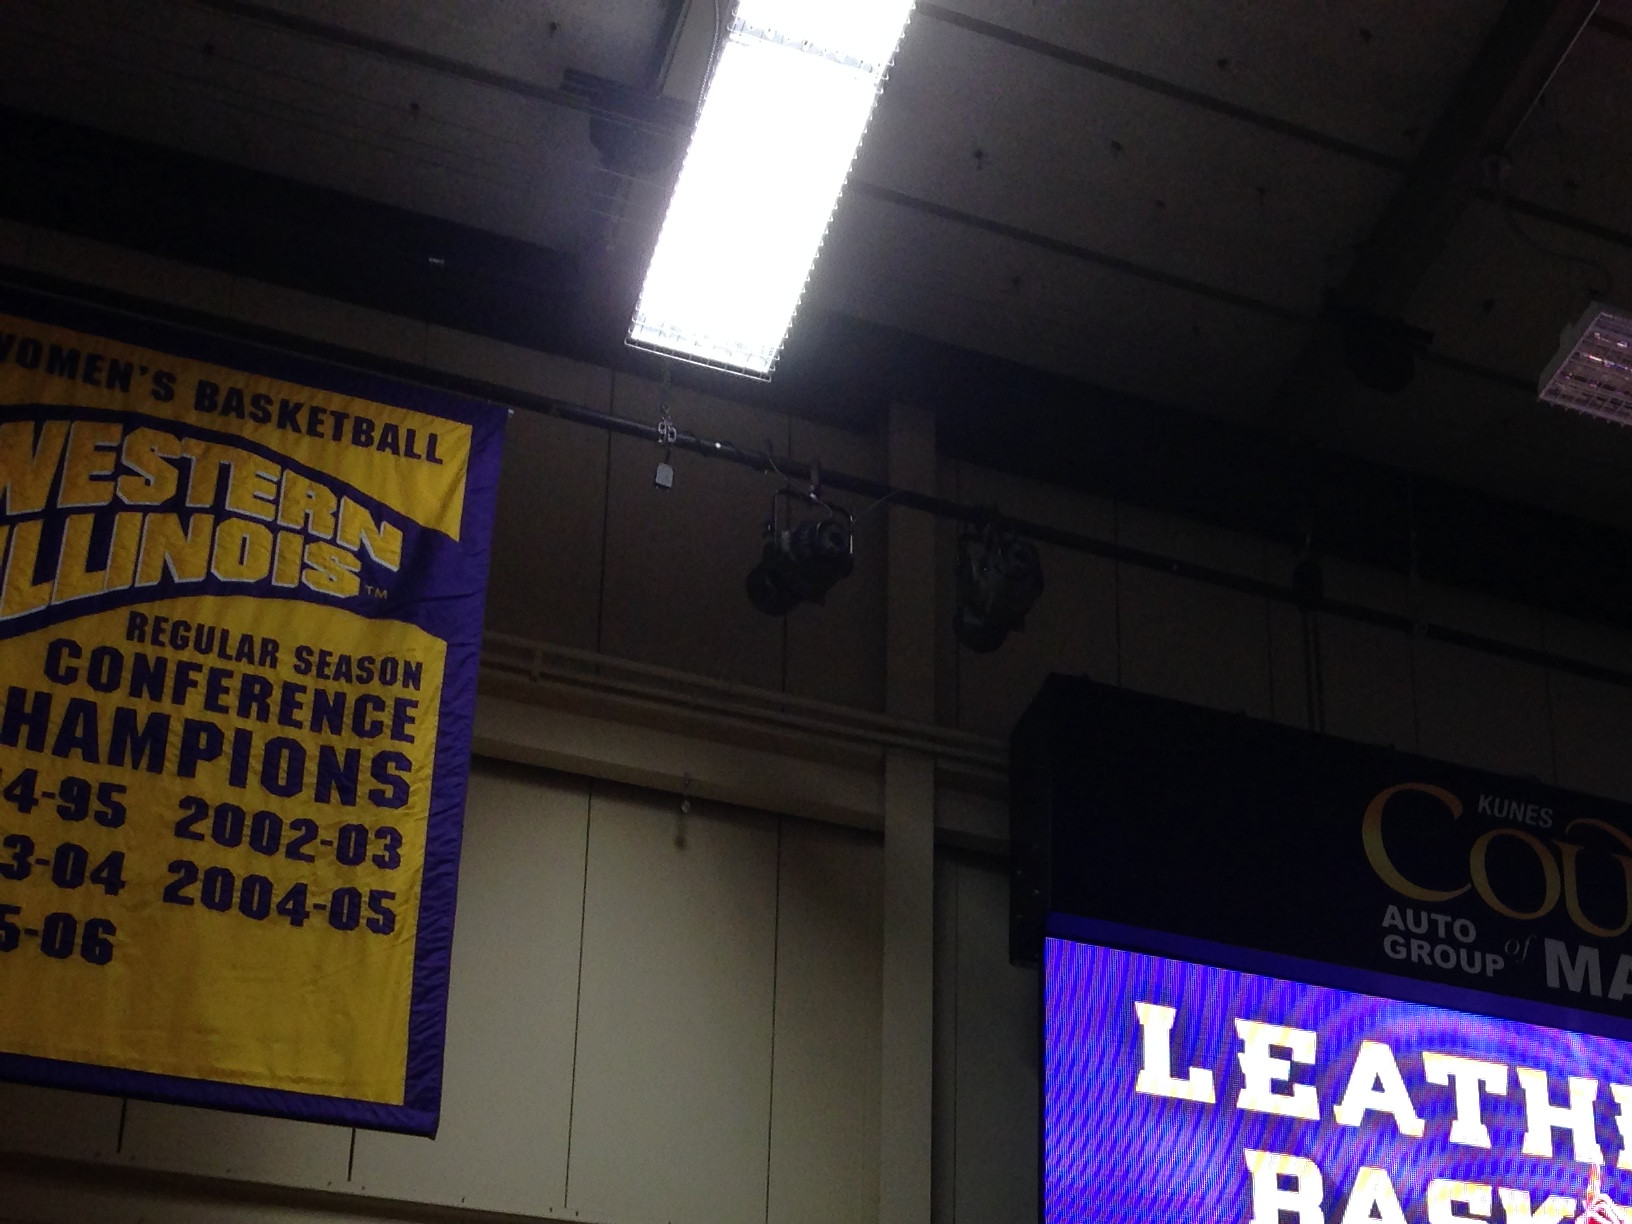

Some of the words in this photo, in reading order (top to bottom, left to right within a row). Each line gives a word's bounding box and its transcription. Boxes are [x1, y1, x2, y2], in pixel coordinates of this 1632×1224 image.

[194, 379, 444, 466] BASKETBALL
[0, 511, 363, 621] LLINOIS
[44, 638, 420, 744] CONFERENCE
[125, 611, 280, 669] REGULAR
[293, 645, 424, 691] SEASON
[0, 686, 413, 809] HAMPIONS
[0, 768, 127, 828] 4-95
[174, 795, 404, 871] 2002-03
[1477, 793, 1554, 829] KUNES
[0, 834, 126, 896] 3-04
[162, 860, 397, 936] 2004-05
[1381, 904, 1477, 943] AUTO
[0, 904, 117, 965] 5-06
[1383, 934, 1505, 977] GROUP
[1504, 934, 1538, 964] of
